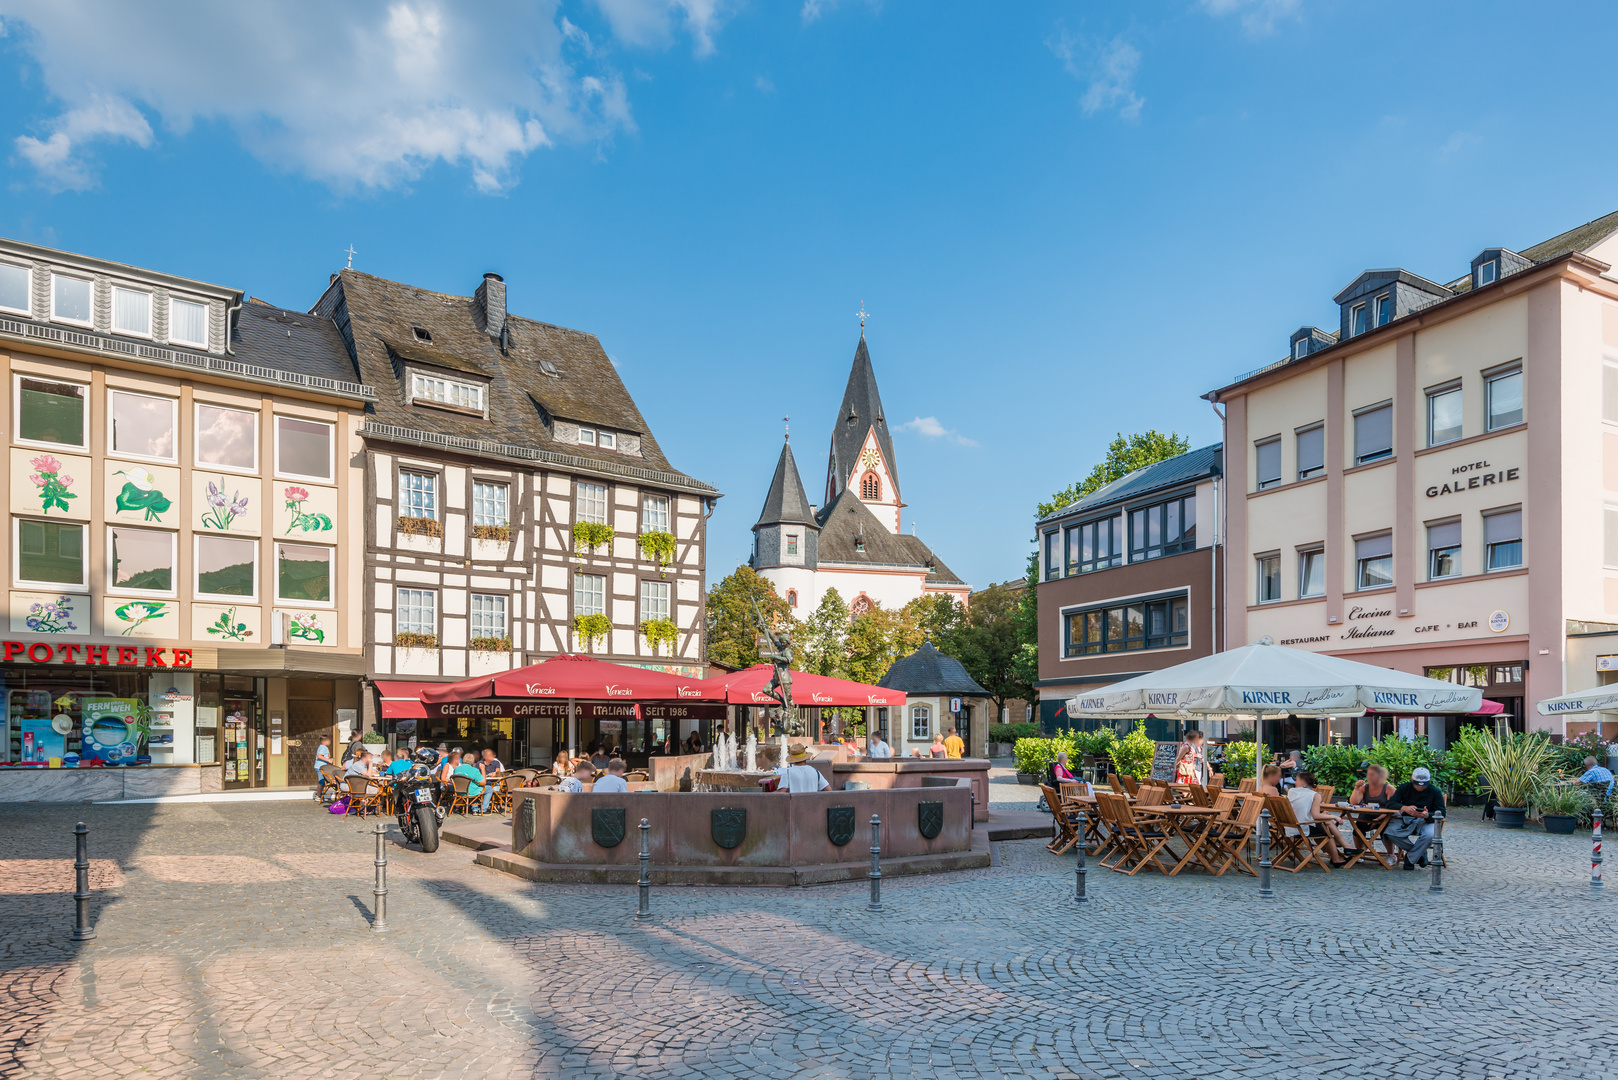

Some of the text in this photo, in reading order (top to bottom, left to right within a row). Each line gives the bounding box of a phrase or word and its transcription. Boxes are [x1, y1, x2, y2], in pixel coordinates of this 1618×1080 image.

[1452, 460, 1491, 475] HOTEL
[1426, 467, 1520, 498] GALERIE
[1348, 605, 1393, 621] Cucina
[1340, 625, 1396, 641] Italiana
[1414, 620, 1479, 633] CAFE BAR
[1280, 635, 1331, 646] RESTAURANT
[2, 641, 193, 668] POTHEKE
[525, 683, 556, 696] Venezia
[605, 684, 633, 697] Venezia
[677, 685, 702, 698] Venezia
[811, 692, 833, 703] Venezia
[1080, 697, 1105, 709] KIRNER
[1148, 692, 1178, 705] KIRNER
[1242, 690, 1293, 704] KIRNER
[1373, 691, 1420, 706] KIRNER
[87, 702, 131, 713] FERN WEH
[440, 704, 503, 716] GELATERIA
[593, 705, 637, 717] ITALIANA
[645, 706, 666, 717] SEIT
[669, 706, 688, 717] 1986
[1547, 700, 1584, 712] KIRNER
